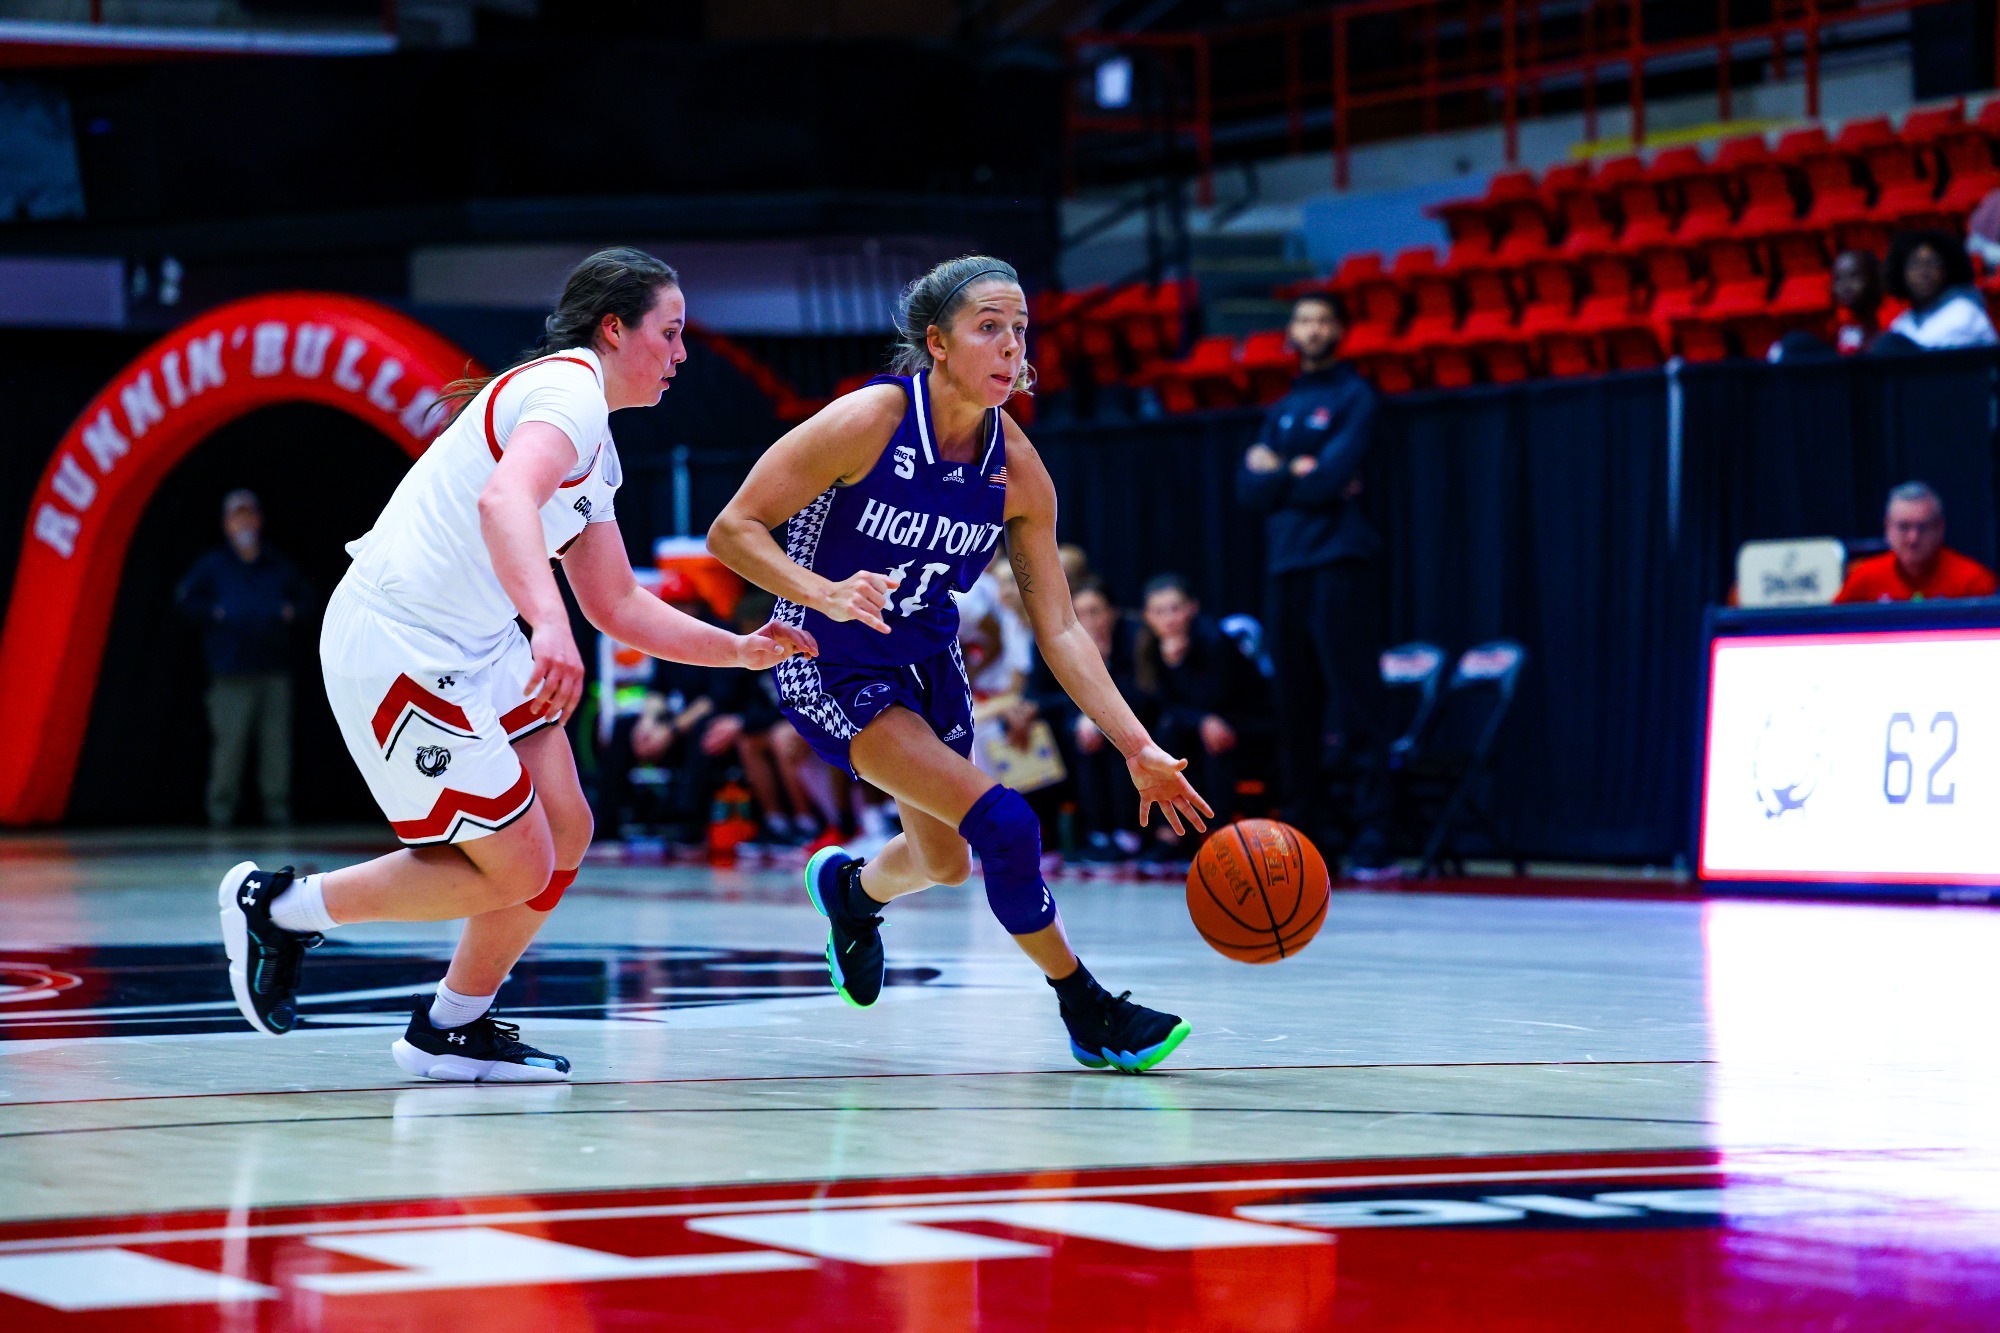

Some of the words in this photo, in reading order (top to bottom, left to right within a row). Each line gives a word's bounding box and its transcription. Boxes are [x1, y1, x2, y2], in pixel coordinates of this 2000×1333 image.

[855, 497, 930, 548] HIGH
[943, 730, 967, 742] adidas
[1883, 711, 1958, 804] 62
